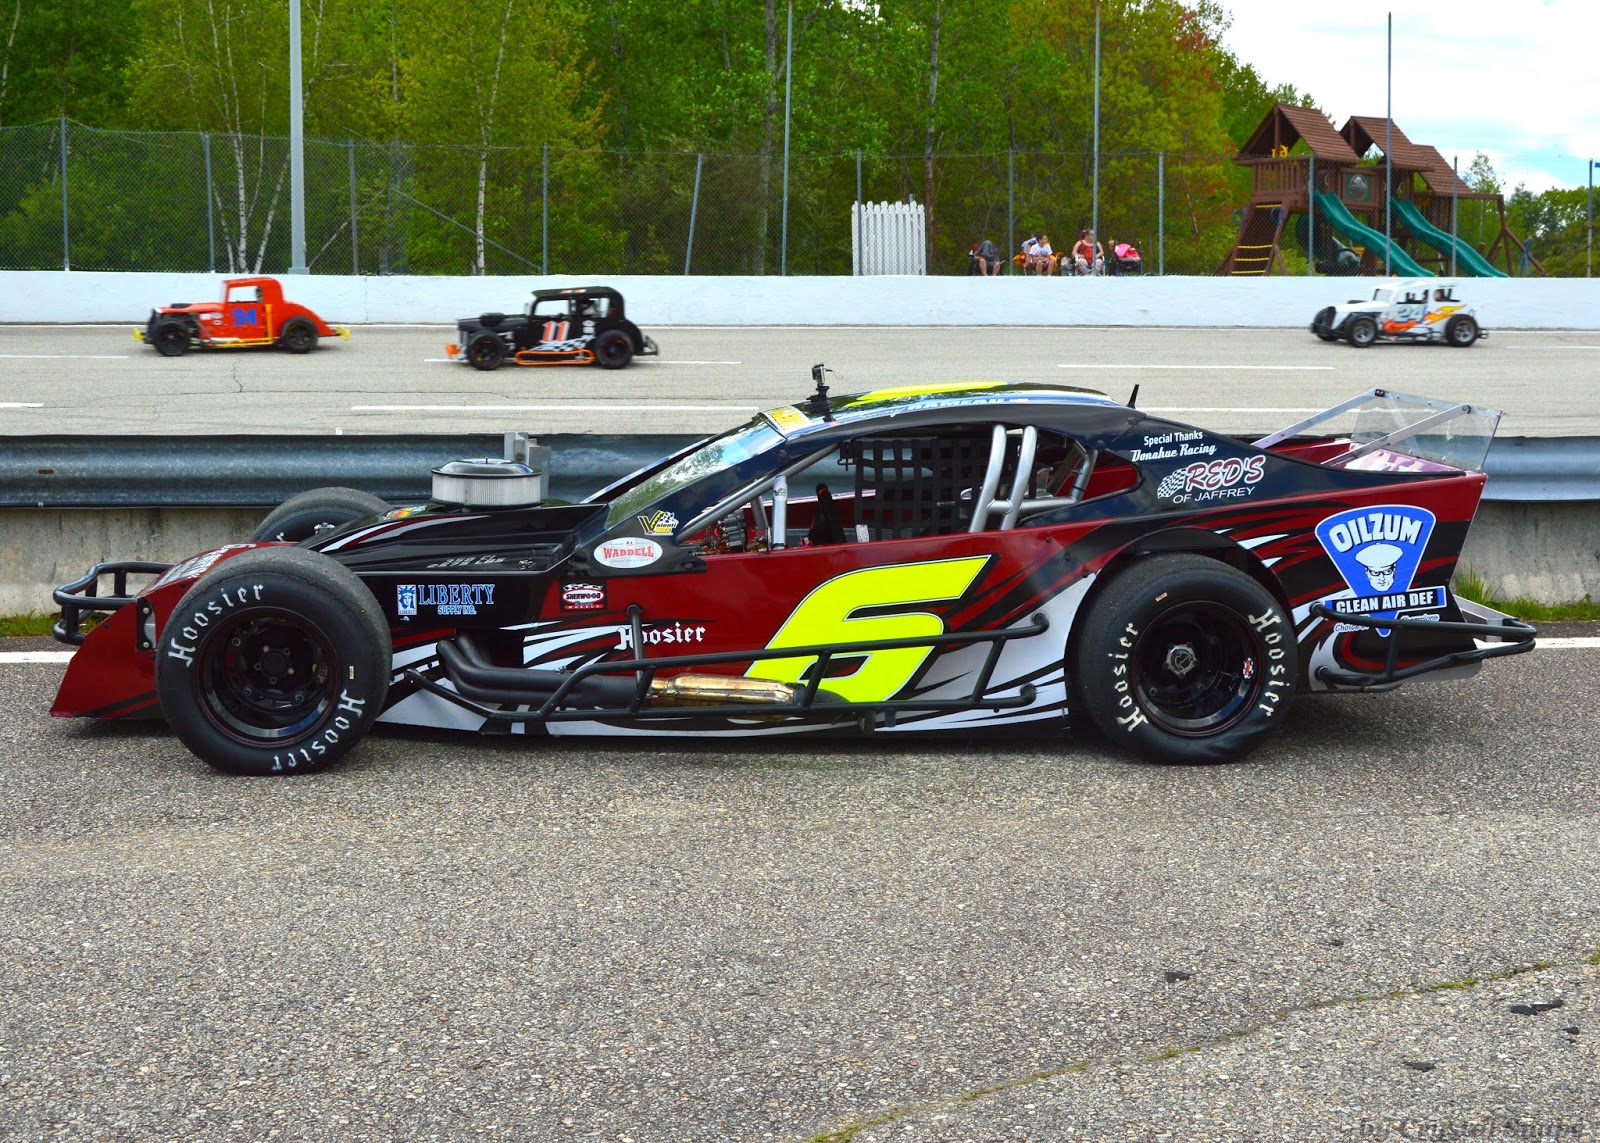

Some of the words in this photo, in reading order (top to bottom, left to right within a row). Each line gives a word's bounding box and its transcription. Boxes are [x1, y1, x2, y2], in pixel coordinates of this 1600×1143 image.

[542, 320, 571, 342] 11
[1143, 432, 1173, 447] Special
[1173, 430, 1204, 443] Thanks
[1130, 447, 1178, 462] Donahue
[1179, 443, 1218, 457] Racing
[1185, 455, 1267, 492] RED'S
[1172, 493, 1193, 504] OF
[1194, 486, 1256, 502] JAFFREY
[1328, 512, 1425, 554] OILZUM
[603, 545, 654, 560] WADDELL
[417, 584, 496, 605] LIBERTY
[1336, 596, 1382, 613] CLEAN
[1382, 594, 1407, 610] AIR
[1409, 591, 1434, 606] DEF
[437, 604, 463, 615] SUPPLY
[167, 582, 264, 668] Hoosier
[742, 553, 993, 704] 6
[1248, 607, 1291, 718] Hoosier
[1108, 622, 1149, 732] Hoosier
[271, 688, 366, 771] Hoosier
